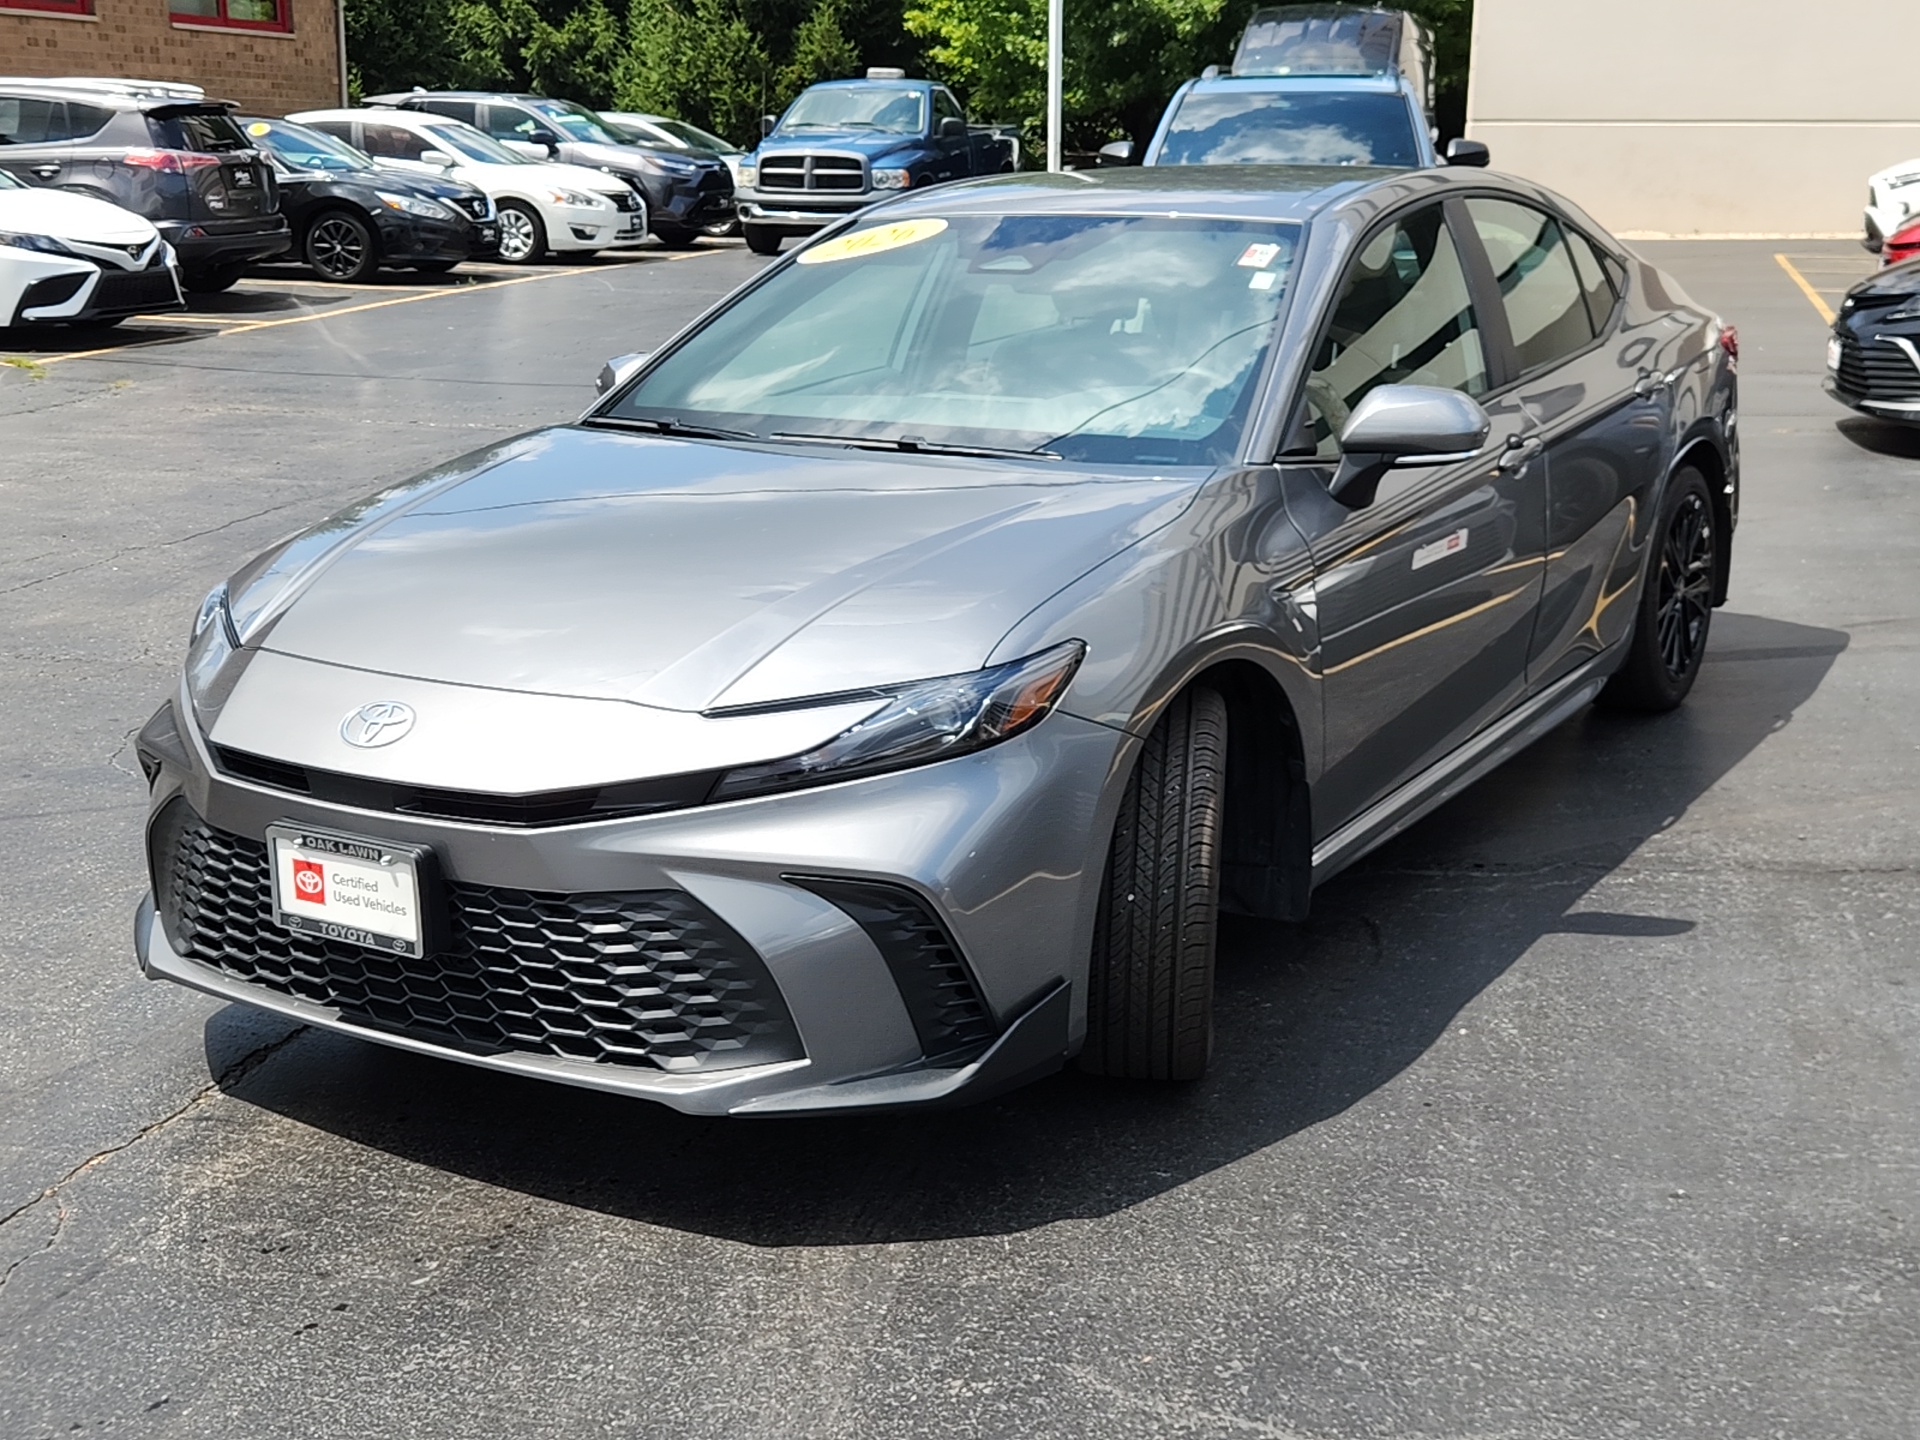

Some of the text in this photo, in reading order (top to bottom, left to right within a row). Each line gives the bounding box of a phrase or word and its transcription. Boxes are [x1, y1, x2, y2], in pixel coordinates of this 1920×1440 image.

[306, 836, 379, 860] OAK LAWN
[332, 873, 379, 892] Certified
[333, 890, 407, 916] Used Vehicles
[319, 922, 376, 945] TOYOTA
